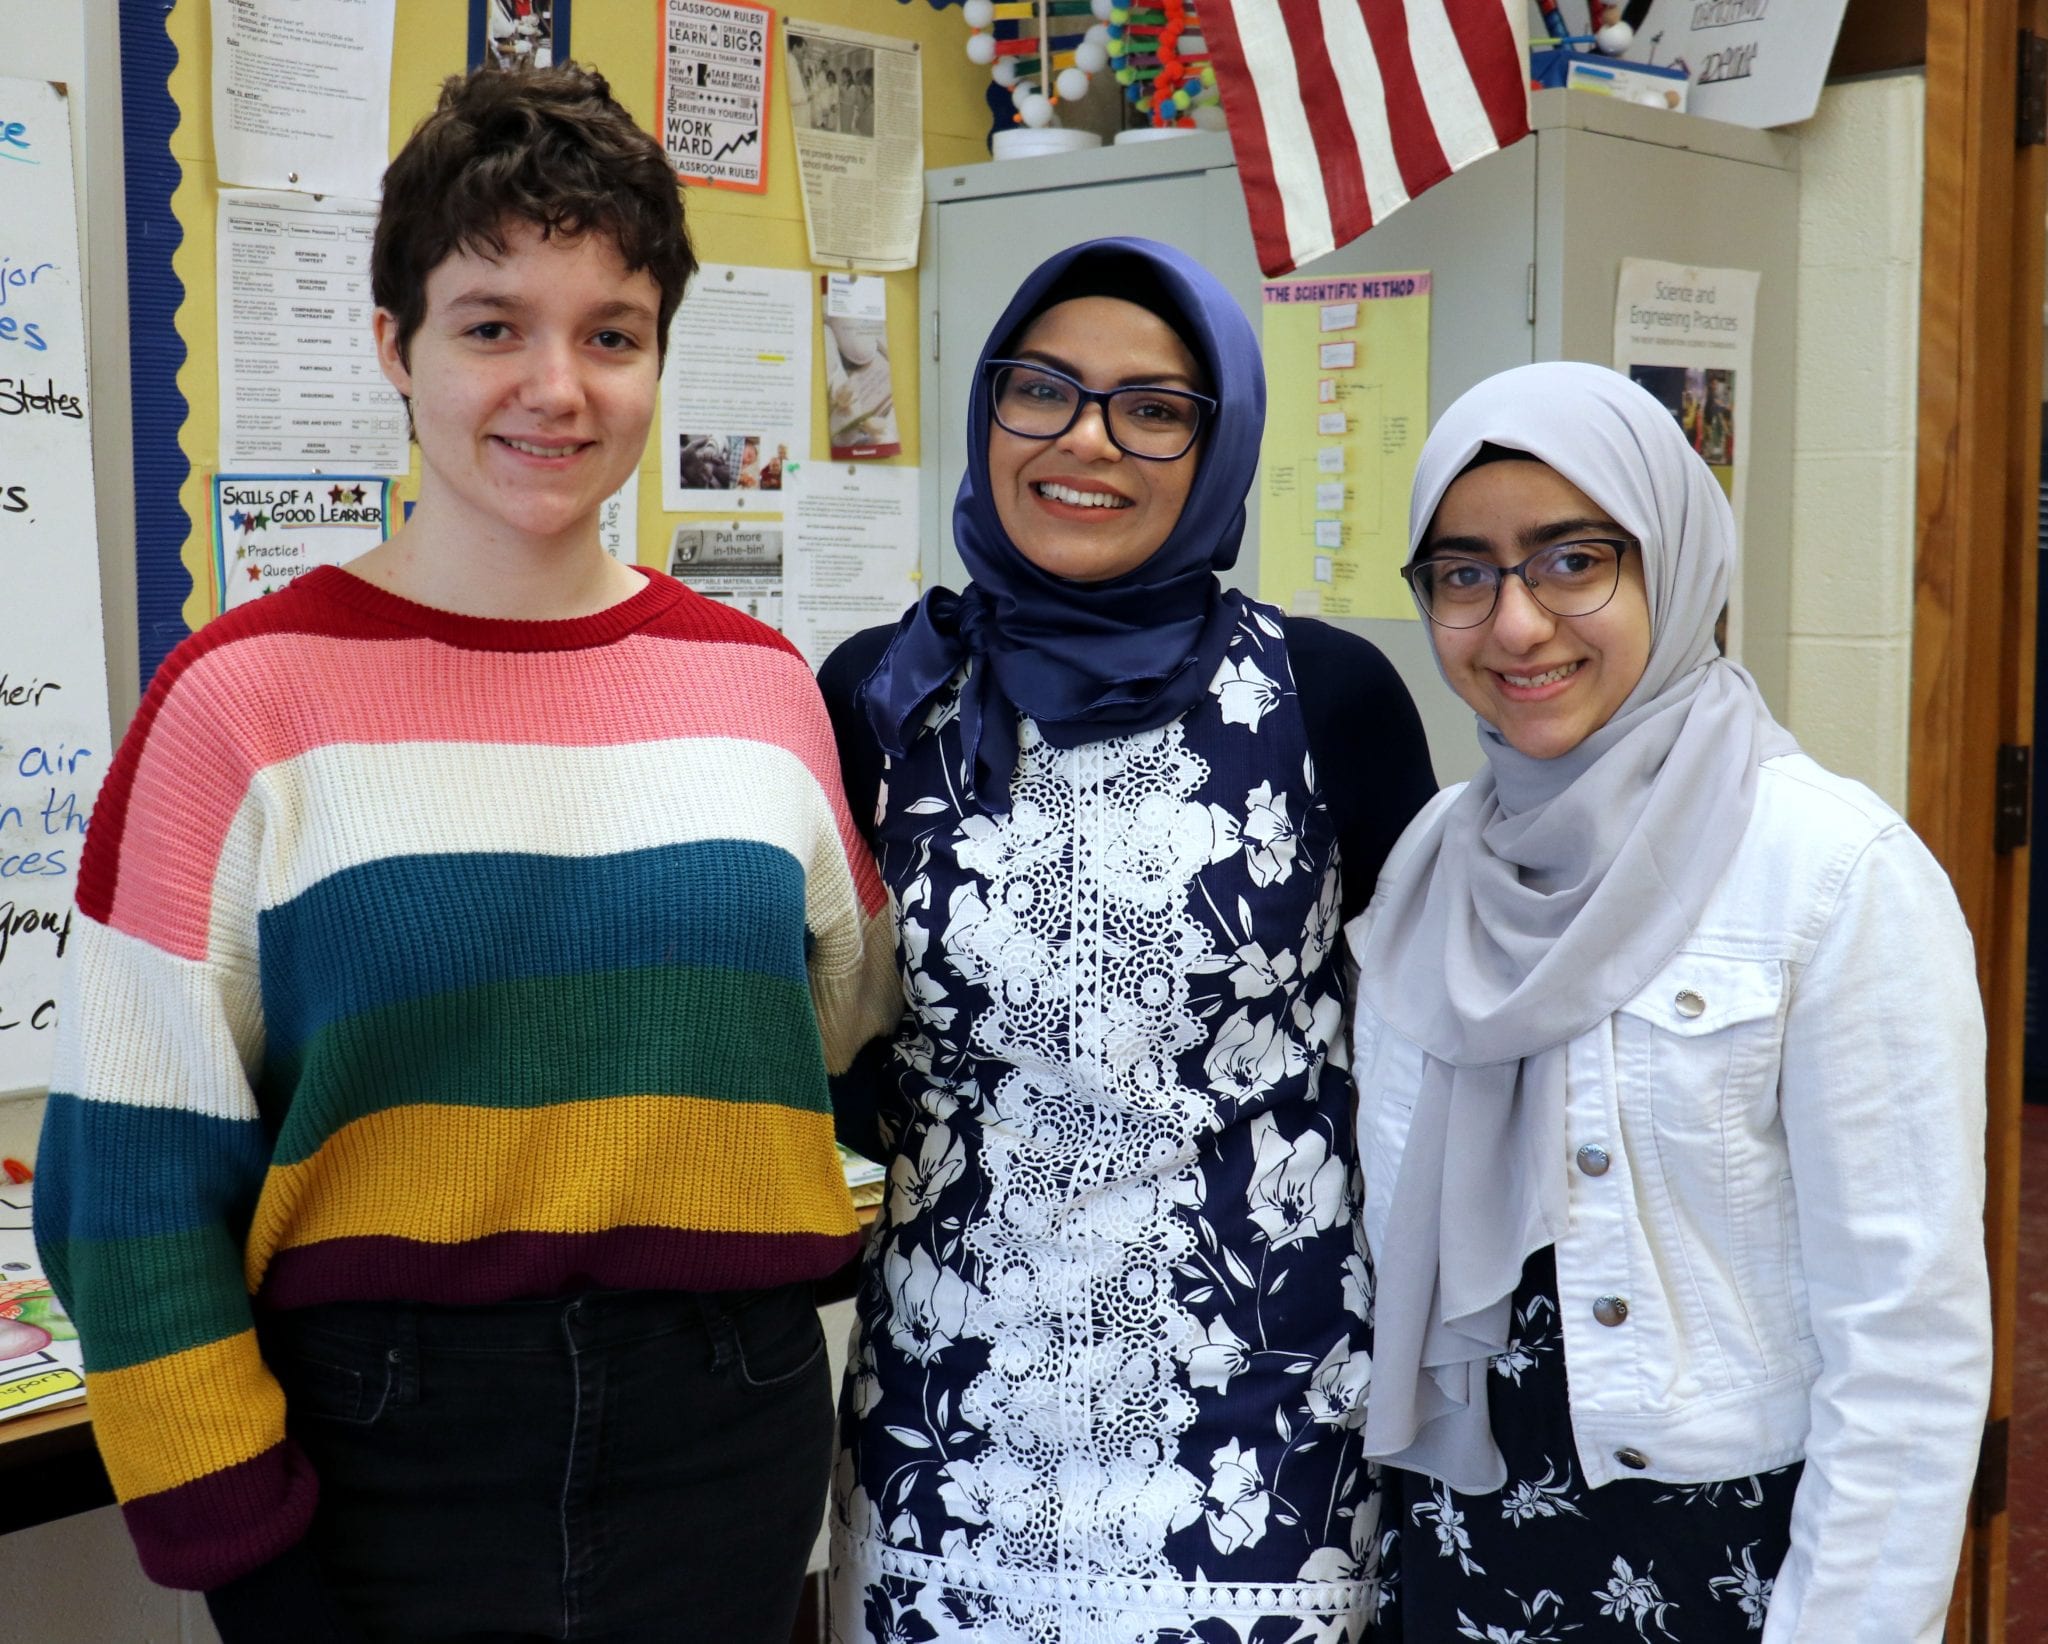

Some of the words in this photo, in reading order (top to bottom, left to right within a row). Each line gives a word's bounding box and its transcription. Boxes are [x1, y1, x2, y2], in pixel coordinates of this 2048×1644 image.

[670, 0, 731, 19] CLASSROOM
[734, 11, 763, 24] RULES!
[669, 27, 708, 45] LEARN
[723, 25, 748, 36] DREAM
[723, 34, 748, 51] BIG
[669, 58, 681, 66] TRY
[710, 69, 731, 79] TAKE
[733, 73, 753, 83] RISKS
[679, 103, 706, 115] BELIEVE
[708, 107, 716, 116] IN
[718, 109, 754, 121] YOURSELF
[667, 117, 713, 138] WORK
[667, 134, 713, 156] HARD
[729, 166, 758, 180] RULES!
[0, 257, 53, 306] jor
[1264, 286, 1290, 303] THE
[1294, 282, 1358, 302] SCIENTIFIC
[1362, 278, 1416, 299] METHOD
[1655, 280, 1693, 303] Science
[1695, 286, 1717, 305] and
[1630, 304, 1691, 334] Engineering
[1693, 310, 1738, 332] Practices
[0, 317, 47, 351] es
[0, 378, 83, 419] States
[223, 486, 274, 505] SKILLS
[280, 490, 299, 504] OF
[304, 491, 314, 504] A
[271, 503, 315, 523] GOOD
[320, 504, 383, 523] LEARNER
[606, 502, 620, 529] Say
[607, 534, 620, 558] Ple
[716, 532, 732, 543] Put
[736, 533, 762, 542] more
[248, 542, 305, 557] Practice!
[18, 742, 92, 778] air
[41, 788, 90, 834] th
[0, 850, 67, 877] ces
